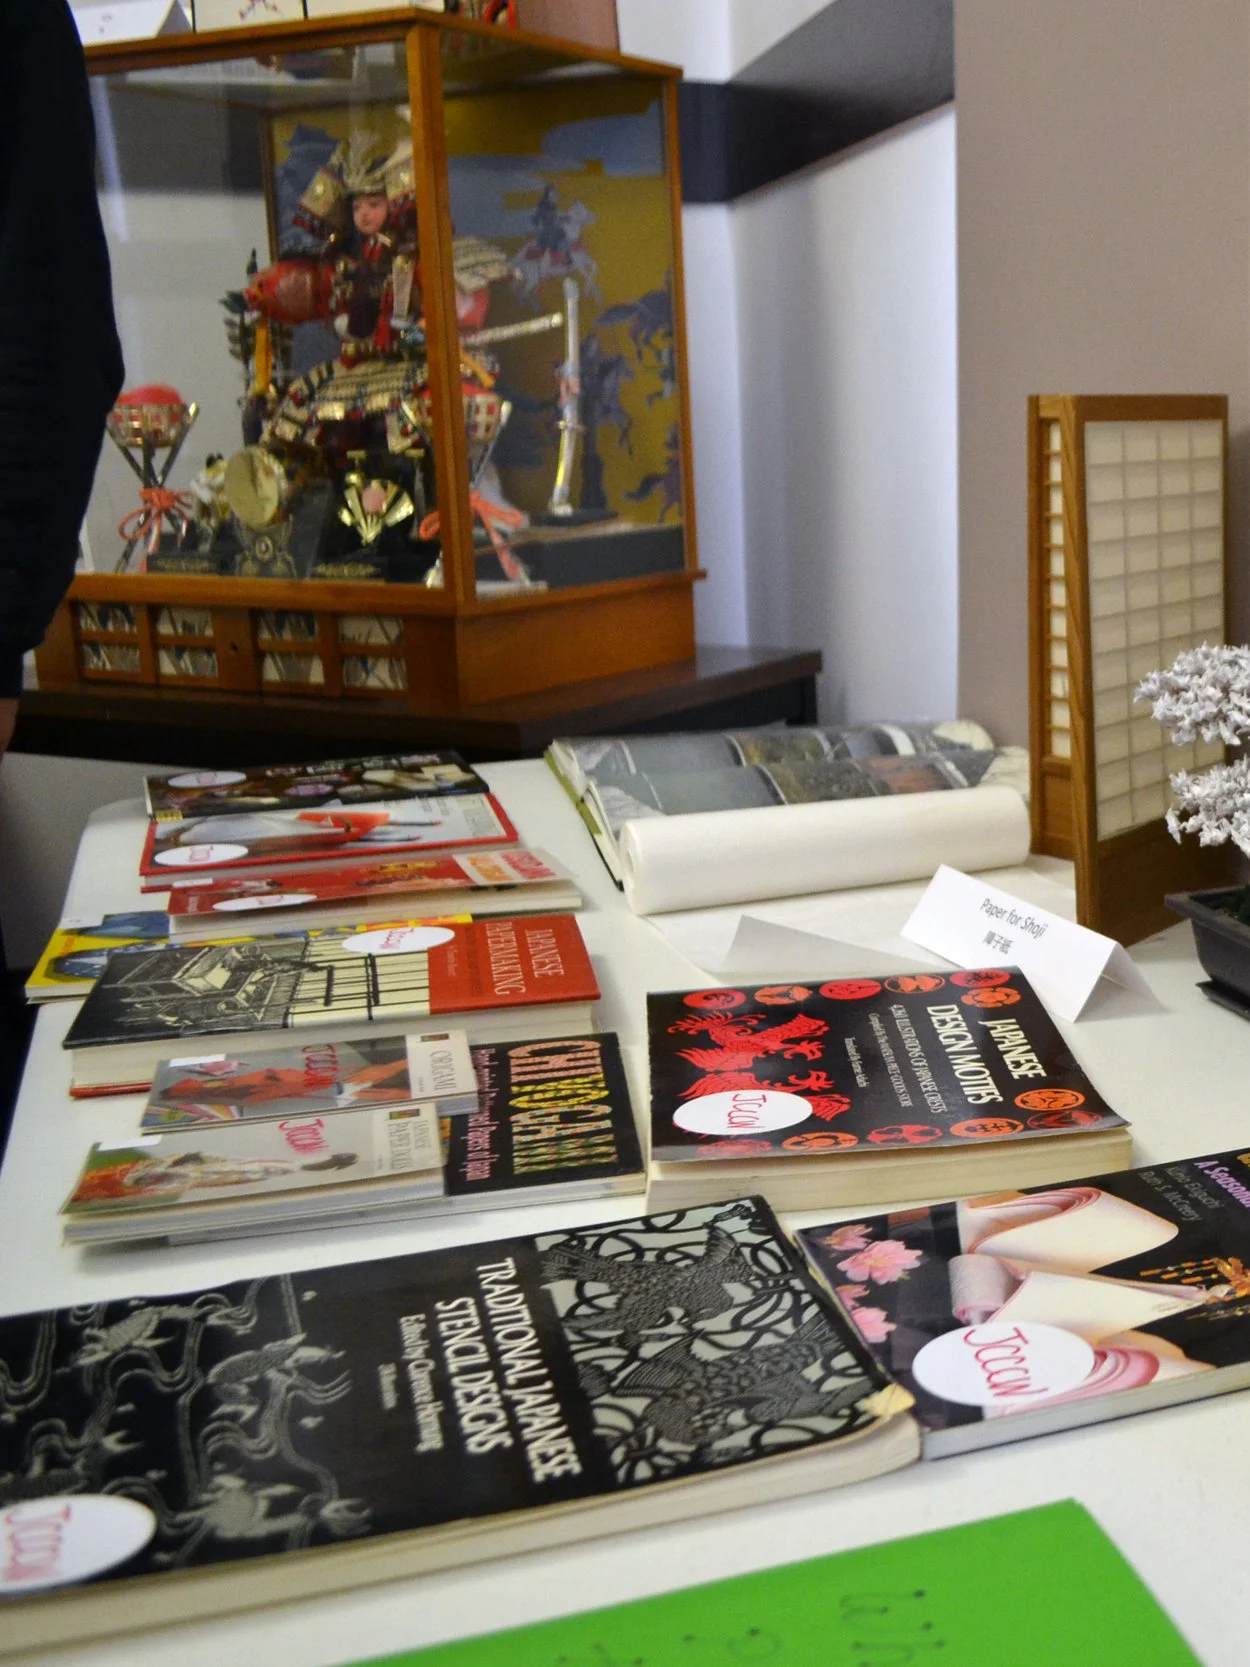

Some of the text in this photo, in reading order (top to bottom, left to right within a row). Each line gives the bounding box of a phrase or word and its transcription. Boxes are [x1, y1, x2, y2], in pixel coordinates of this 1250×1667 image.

[980, 897, 1049, 940] Paper for Shoji
[485, 921, 527, 996] PAPERMAKING
[525, 929, 564, 979] JAPANESE
[430, 1050, 457, 1092] ORIGAMI
[894, 1018, 924, 1057] ILLUSTRATIONS
[911, 1066, 938, 1091] JAPANESE
[926, 1090, 948, 1114] CRESTS
[926, 1004, 1003, 1105] DESIGN MOTIFS
[978, 1018, 1047, 1080] JAPANESE
[508, 1040, 619, 1175] CHIYOGAMI
[461, 1125, 497, 1150] Papers
[467, 1150, 500, 1160] of
[1193, 1160, 1220, 1169] A
[459, 1158, 499, 1182] Japan
[399, 1313, 429, 1346] Edited
[434, 1296, 515, 1455] STENCIL DESIGNS
[476, 1256, 583, 1483] TRADITIONAL JAPANESE
[963, 1327, 1050, 1397] JCCCW
